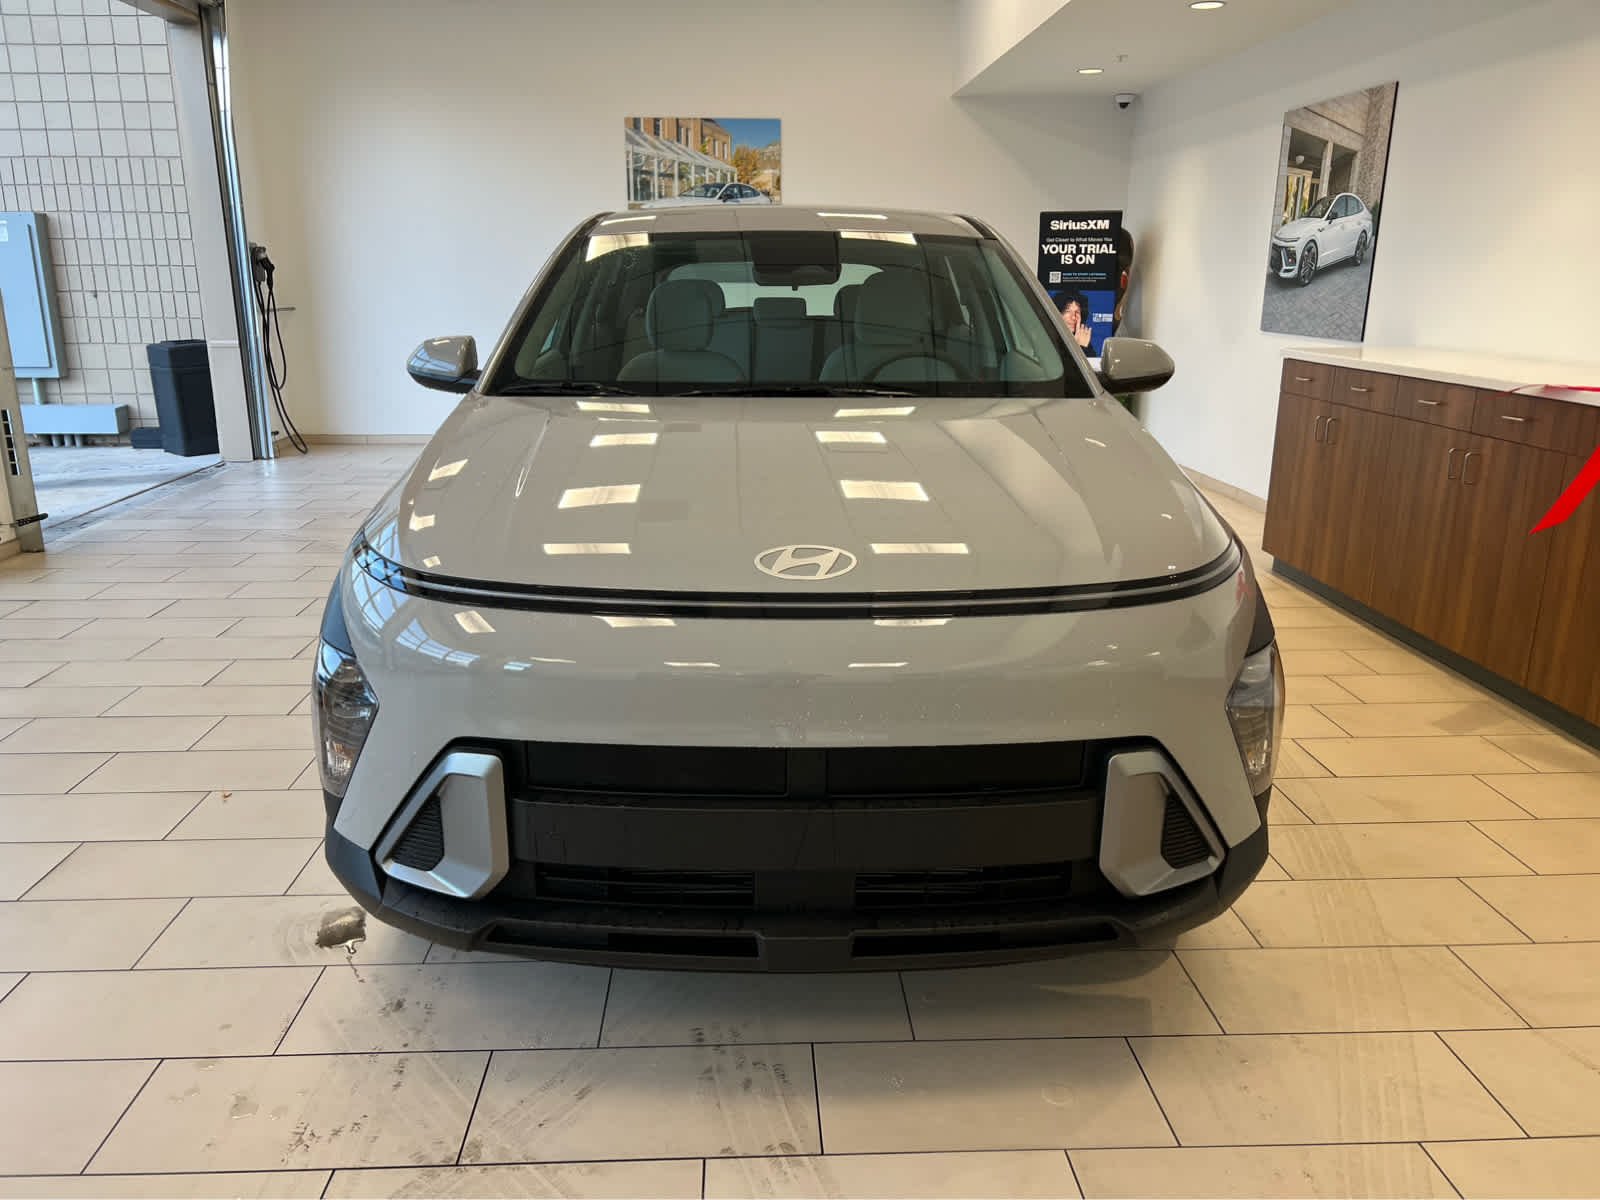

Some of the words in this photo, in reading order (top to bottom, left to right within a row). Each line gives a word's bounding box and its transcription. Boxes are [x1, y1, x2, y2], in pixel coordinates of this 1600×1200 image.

[1050, 219, 1110, 230] SiriusXM
[1041, 243, 1077, 254] YOUR
[1079, 243, 1117, 254] TRIAL
[1061, 254, 1073, 265] IS
[1075, 254, 1095, 265] ON
